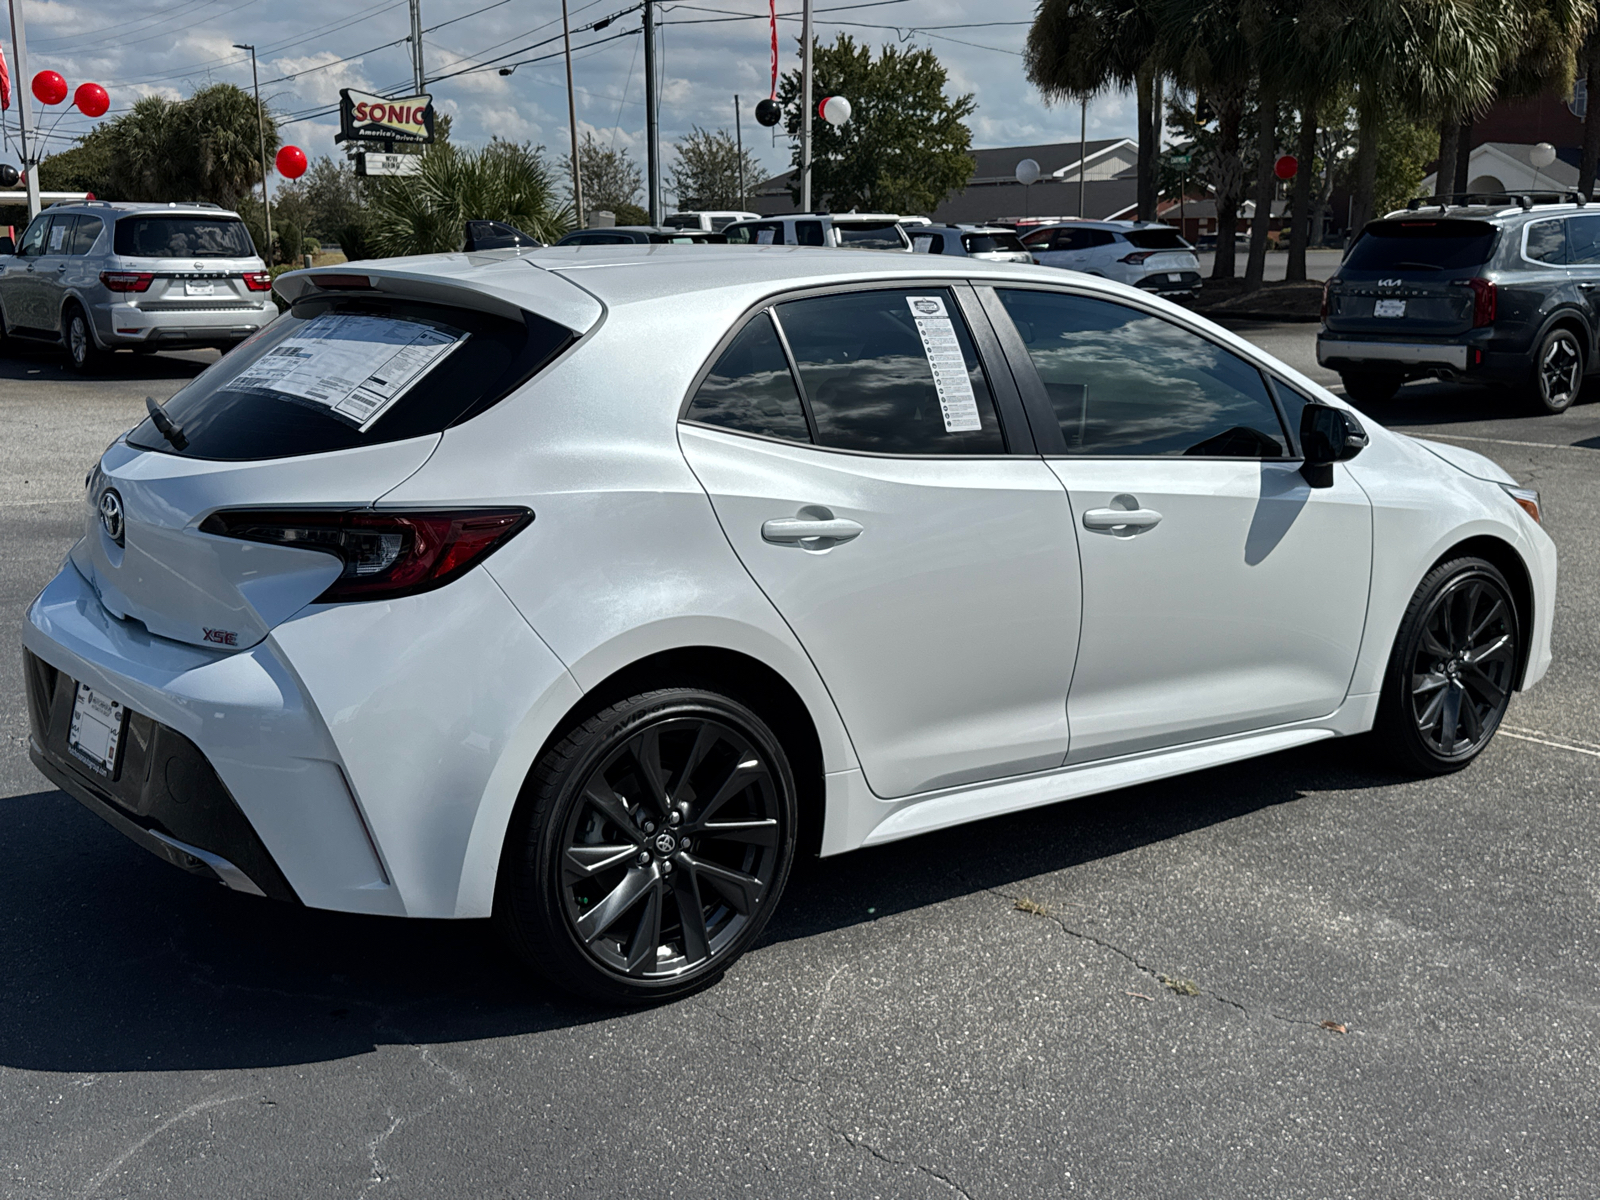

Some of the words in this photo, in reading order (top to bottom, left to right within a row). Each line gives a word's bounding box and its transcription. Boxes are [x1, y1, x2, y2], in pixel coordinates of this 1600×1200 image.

[356, 102, 426, 125] SONIC
[359, 129, 395, 137] America's
[202, 626, 238, 647] XSE
[612, 709, 647, 736] AVID
